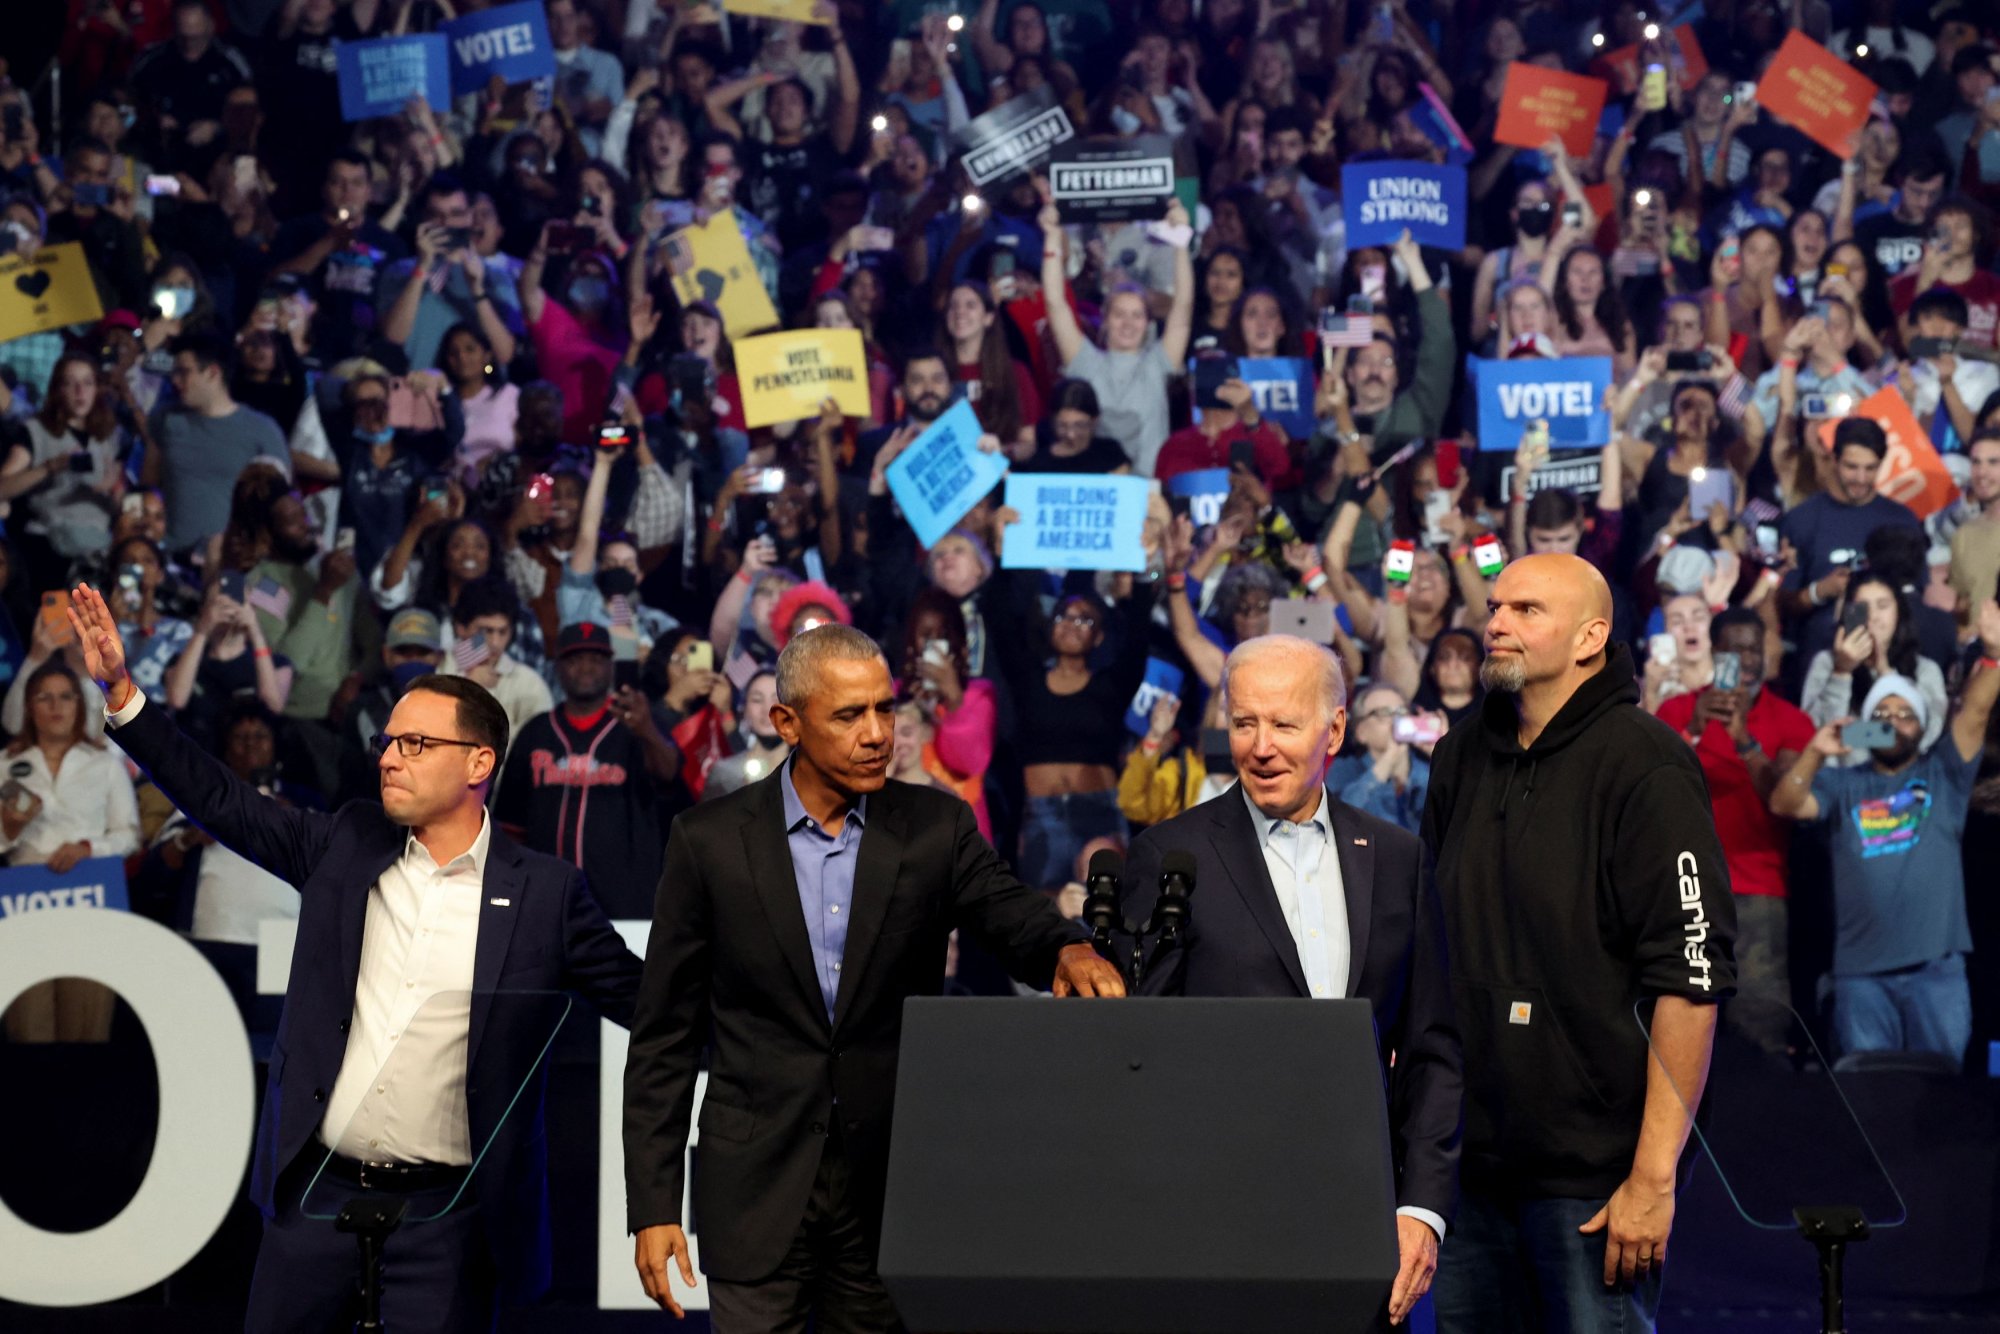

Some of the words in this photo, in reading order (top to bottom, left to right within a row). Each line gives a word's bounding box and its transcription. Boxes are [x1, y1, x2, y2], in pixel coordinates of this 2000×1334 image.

[454, 22, 535, 67] VOTE!
[1060, 166, 1164, 190] FETTERMAN
[1368, 177, 1441, 200] UNION
[1360, 198, 1449, 226] STRONG
[786, 348, 820, 365] VOTE
[753, 367, 855, 391] PENNSYLVANIA
[1252, 380, 1299, 411] TE!
[1498, 382, 1593, 419] VOTE!
[1529, 464, 1598, 490] TTERMAN
[1036, 486, 1117, 505] BUILDING
[1036, 509, 1049, 527] A
[1053, 508, 1115, 528] BETTER
[1036, 531, 1112, 550] AMERICA
